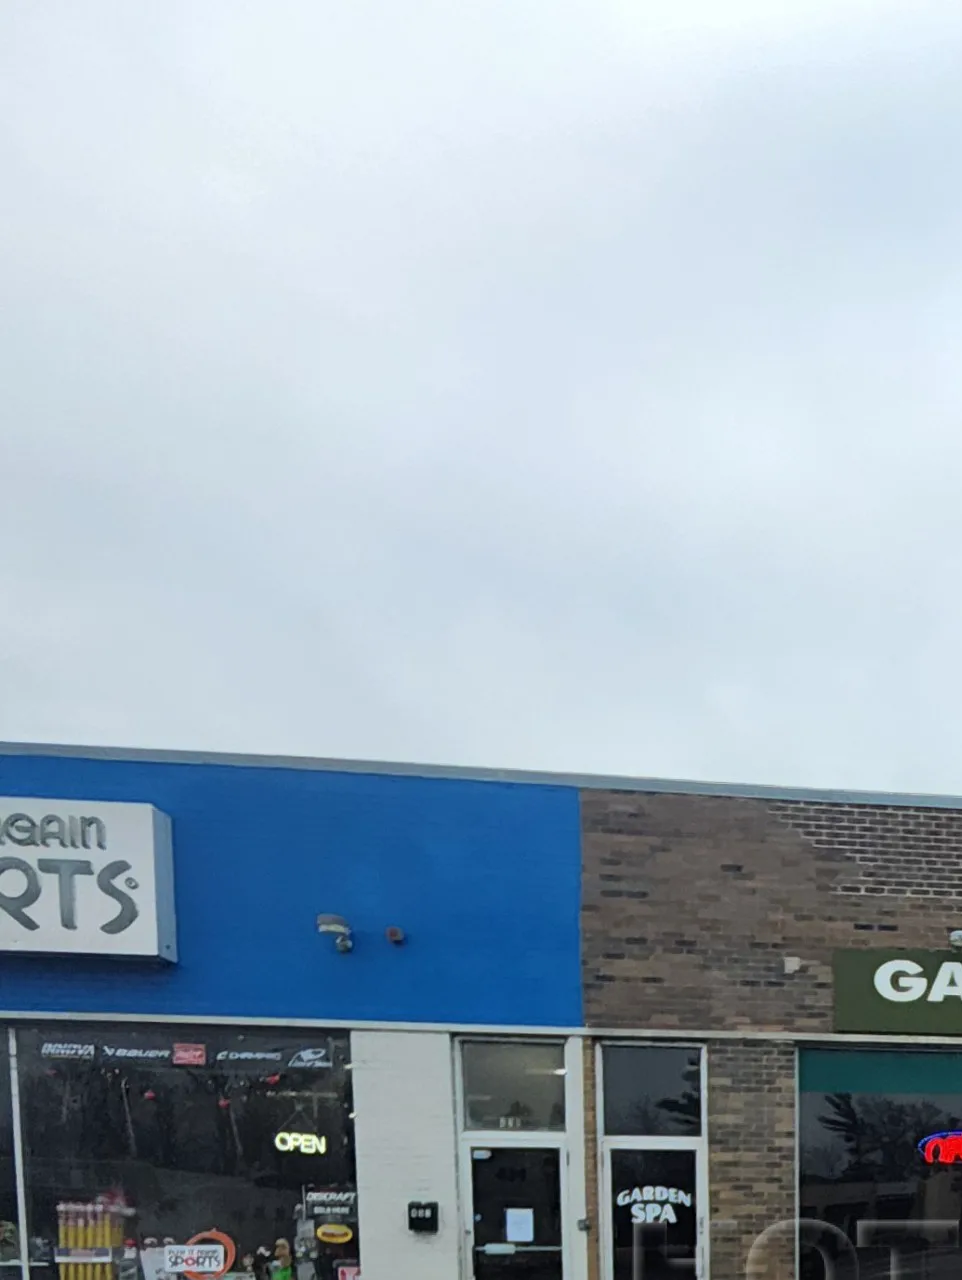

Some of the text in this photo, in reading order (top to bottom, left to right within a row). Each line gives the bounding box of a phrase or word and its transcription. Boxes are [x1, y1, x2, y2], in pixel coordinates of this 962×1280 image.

[0, 812, 107, 850] GAIN
[274, 1132, 326, 1154] OPEN
[616, 1186, 692, 1207] GARDEN
[630, 1203, 677, 1224] SPA
[168, 1255, 221, 1268] SPORTS
